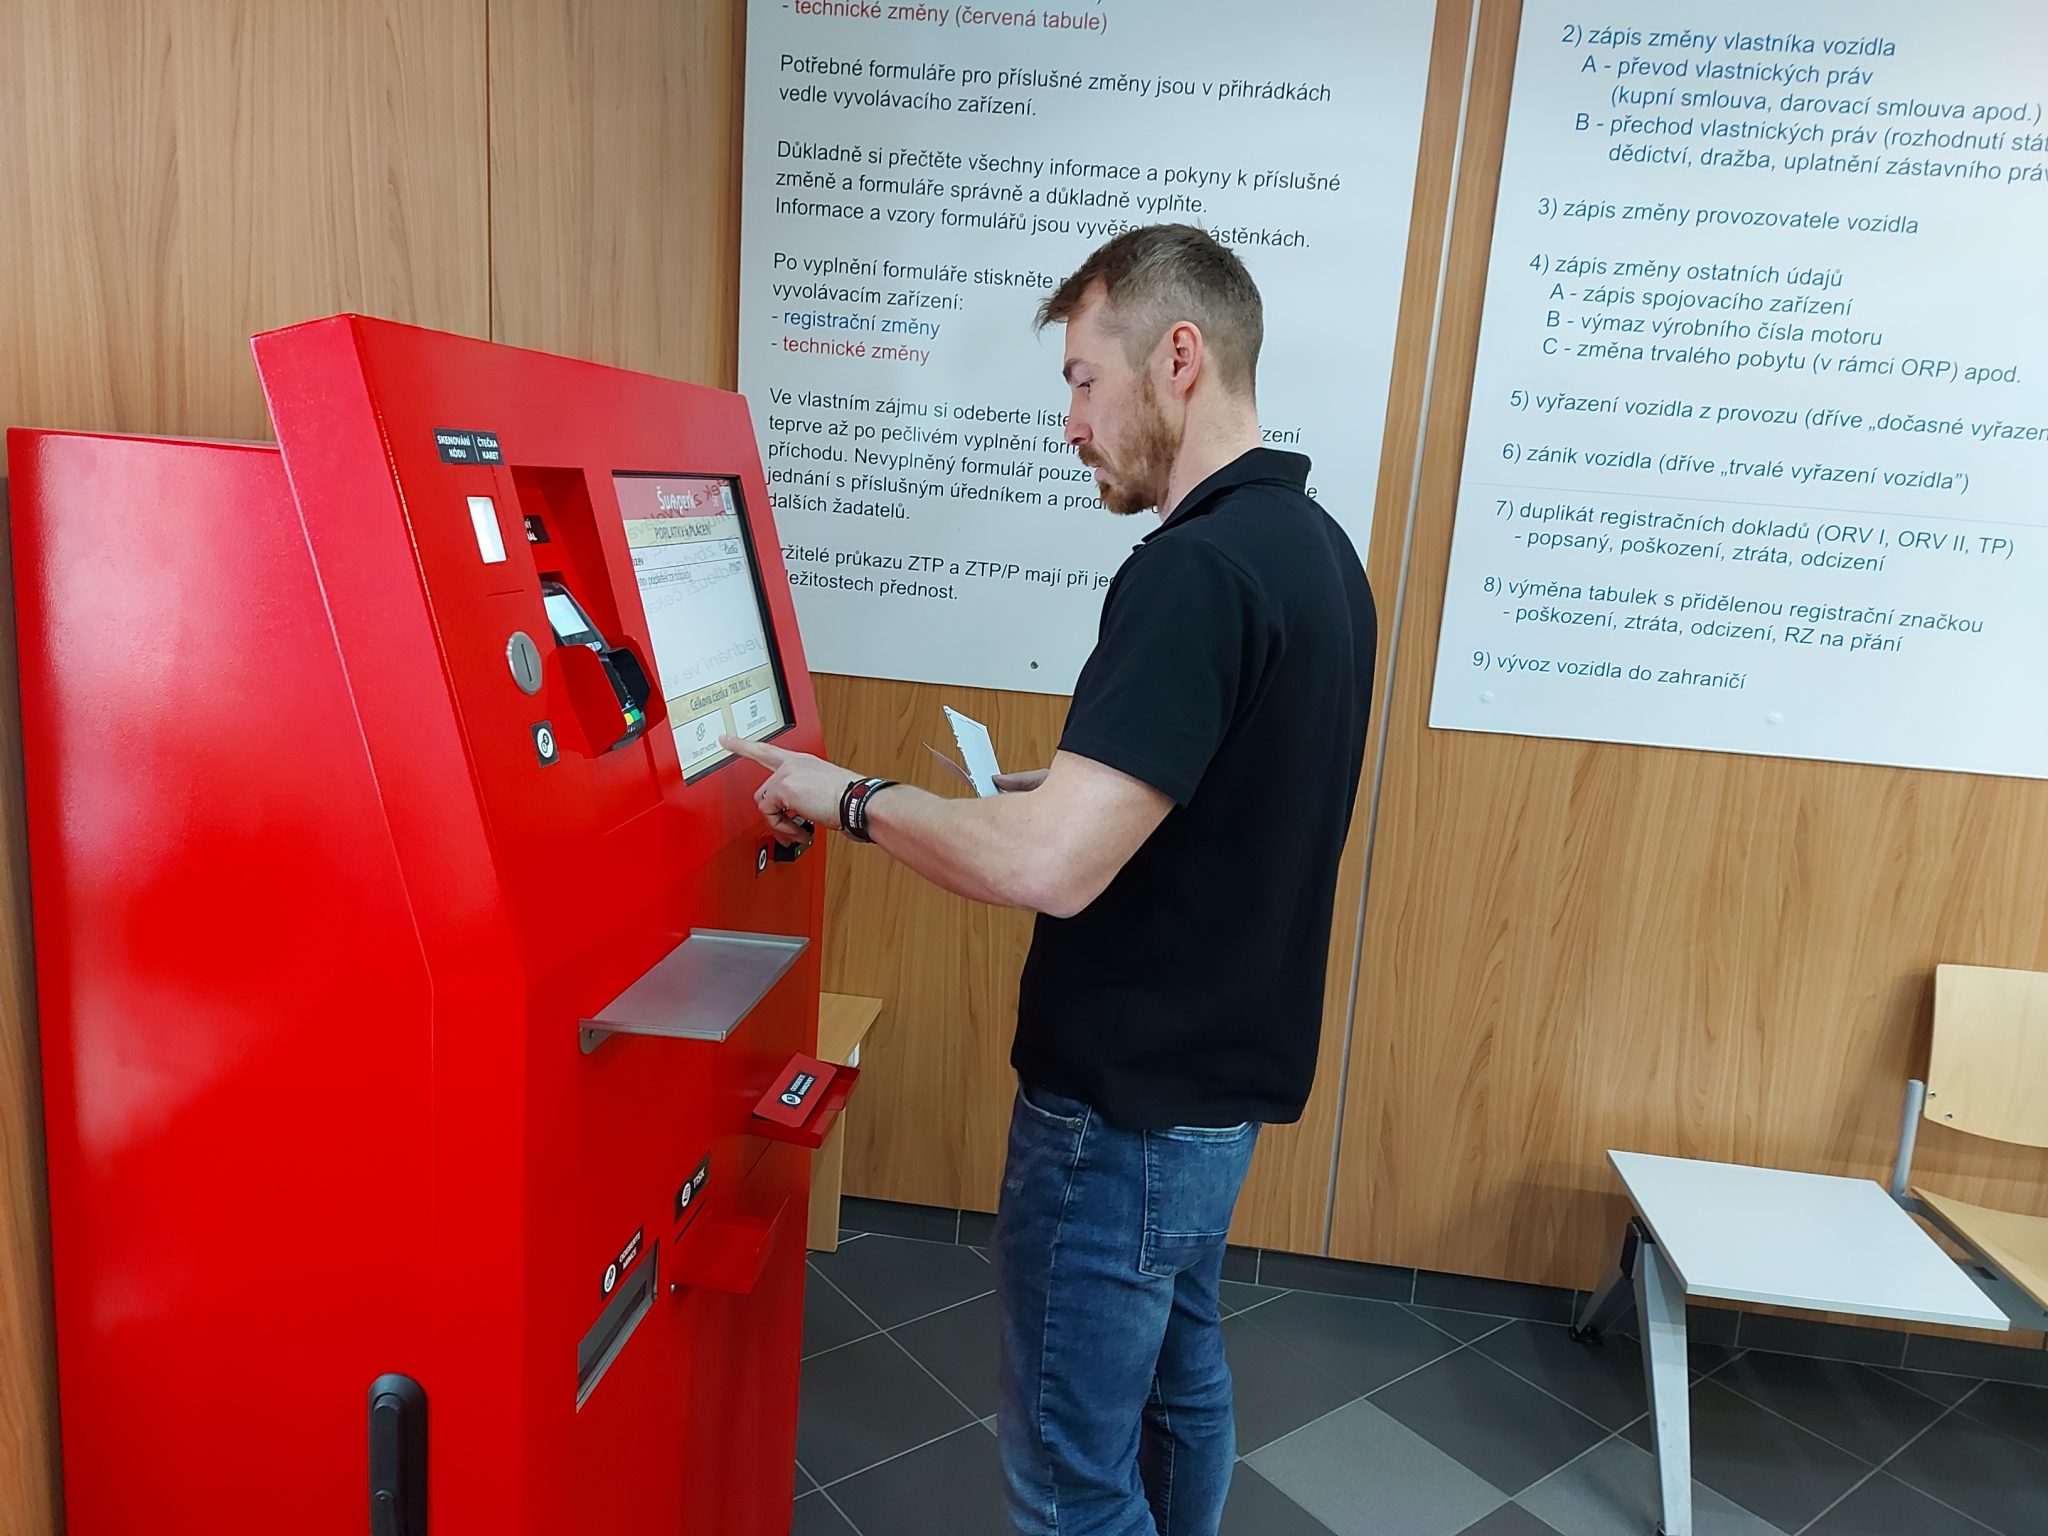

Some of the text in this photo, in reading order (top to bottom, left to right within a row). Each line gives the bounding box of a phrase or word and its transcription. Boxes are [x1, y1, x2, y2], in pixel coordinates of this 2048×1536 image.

[795, 0, 1107, 35] technické změny (červená tabule)
[1588, 26, 1895, 56] zápis změny vlastníka vozidla
[781, 54, 1330, 102] Potřebné formuláře pro příslušné změny jsou přihrádkách
[1618, 56, 1874, 88] převod vlastnických práv
[779, 85, 1036, 116] vedle vyvolávacího zařízení.
[1612, 85, 2041, 127] (kupní smlouva, darovací smlouva apod.)
[1610, 115, 2007, 150] přechod vlastnických práv (rozhodnutí
[778, 141, 1340, 192] Důkladně přečtěte všechny informace pokyny příslušné
[1609, 144, 2001, 179] dědictví, dražba, uplatnění zástavního
[776, 171, 1206, 220] změně formuláře správně důkladně vyplňte.
[776, 197, 1069, 236] Informace vzory formulářů jsou
[1563, 199, 1918, 234] zápis změny provozovatele vozidla
[803, 257, 878, 276] vyplnění
[883, 261, 967, 282] formuláře
[974, 268, 1053, 289] stiskněte
[1555, 256, 1842, 291] zápis změny ostatních údajů
[773, 283, 963, 310] vyvolávacím zařízení:
[1583, 285, 1853, 316] zápis spojovacího zařízení
[785, 310, 940, 340] registrační změny
[1582, 313, 1882, 345] výmaz výrobního čísla motoru
[783, 336, 930, 366] technické změny
[1577, 342, 2021, 385] změna trvalého pobytu rámci ORP) apod.
[770, 388, 1031, 424] Ve vlastním zájmu odeberte
[1536, 393, 1619, 413] vyřazení
[1625, 399, 1693, 418] vozidla
[1717, 408, 1798, 424] provozu
[1805, 408, 1862, 430] (dříve
[477, 437, 498, 448] ČTEČKA
[769, 415, 1037, 451] teprve pečlivém vyplnění
[449, 447, 466, 459] KÓDU
[482, 451, 499, 460] KARET
[769, 441, 1092, 483] příchodu. Nevyplněný formulář pouze
[1527, 445, 1578, 464] zánik
[1585, 451, 1651, 469] vozidla
[1659, 454, 1714, 474] (dříve
[1792, 464, 1878, 484] vyřazení
[766, 466, 1041, 504] jednání příslušným úředníkem
[832, 498, 909, 519] žadatelů.
[1520, 502, 2013, 560] duplikát registračních dokladů (ORV ORV TP)
[836, 550, 1088, 588] průkazu ZTP ZTP/P mají při
[1527, 533, 1886, 571] popsaný, poškození, ztráta, odcizení
[880, 579, 957, 599] přednost.
[1509, 579, 1983, 633] výměna tabulek přidělenou registrační značkou
[1516, 606, 1904, 652] poškození, ztráta, odcizení, RZ přání
[1497, 654, 1747, 689] vývoz vozidla zahraničí
